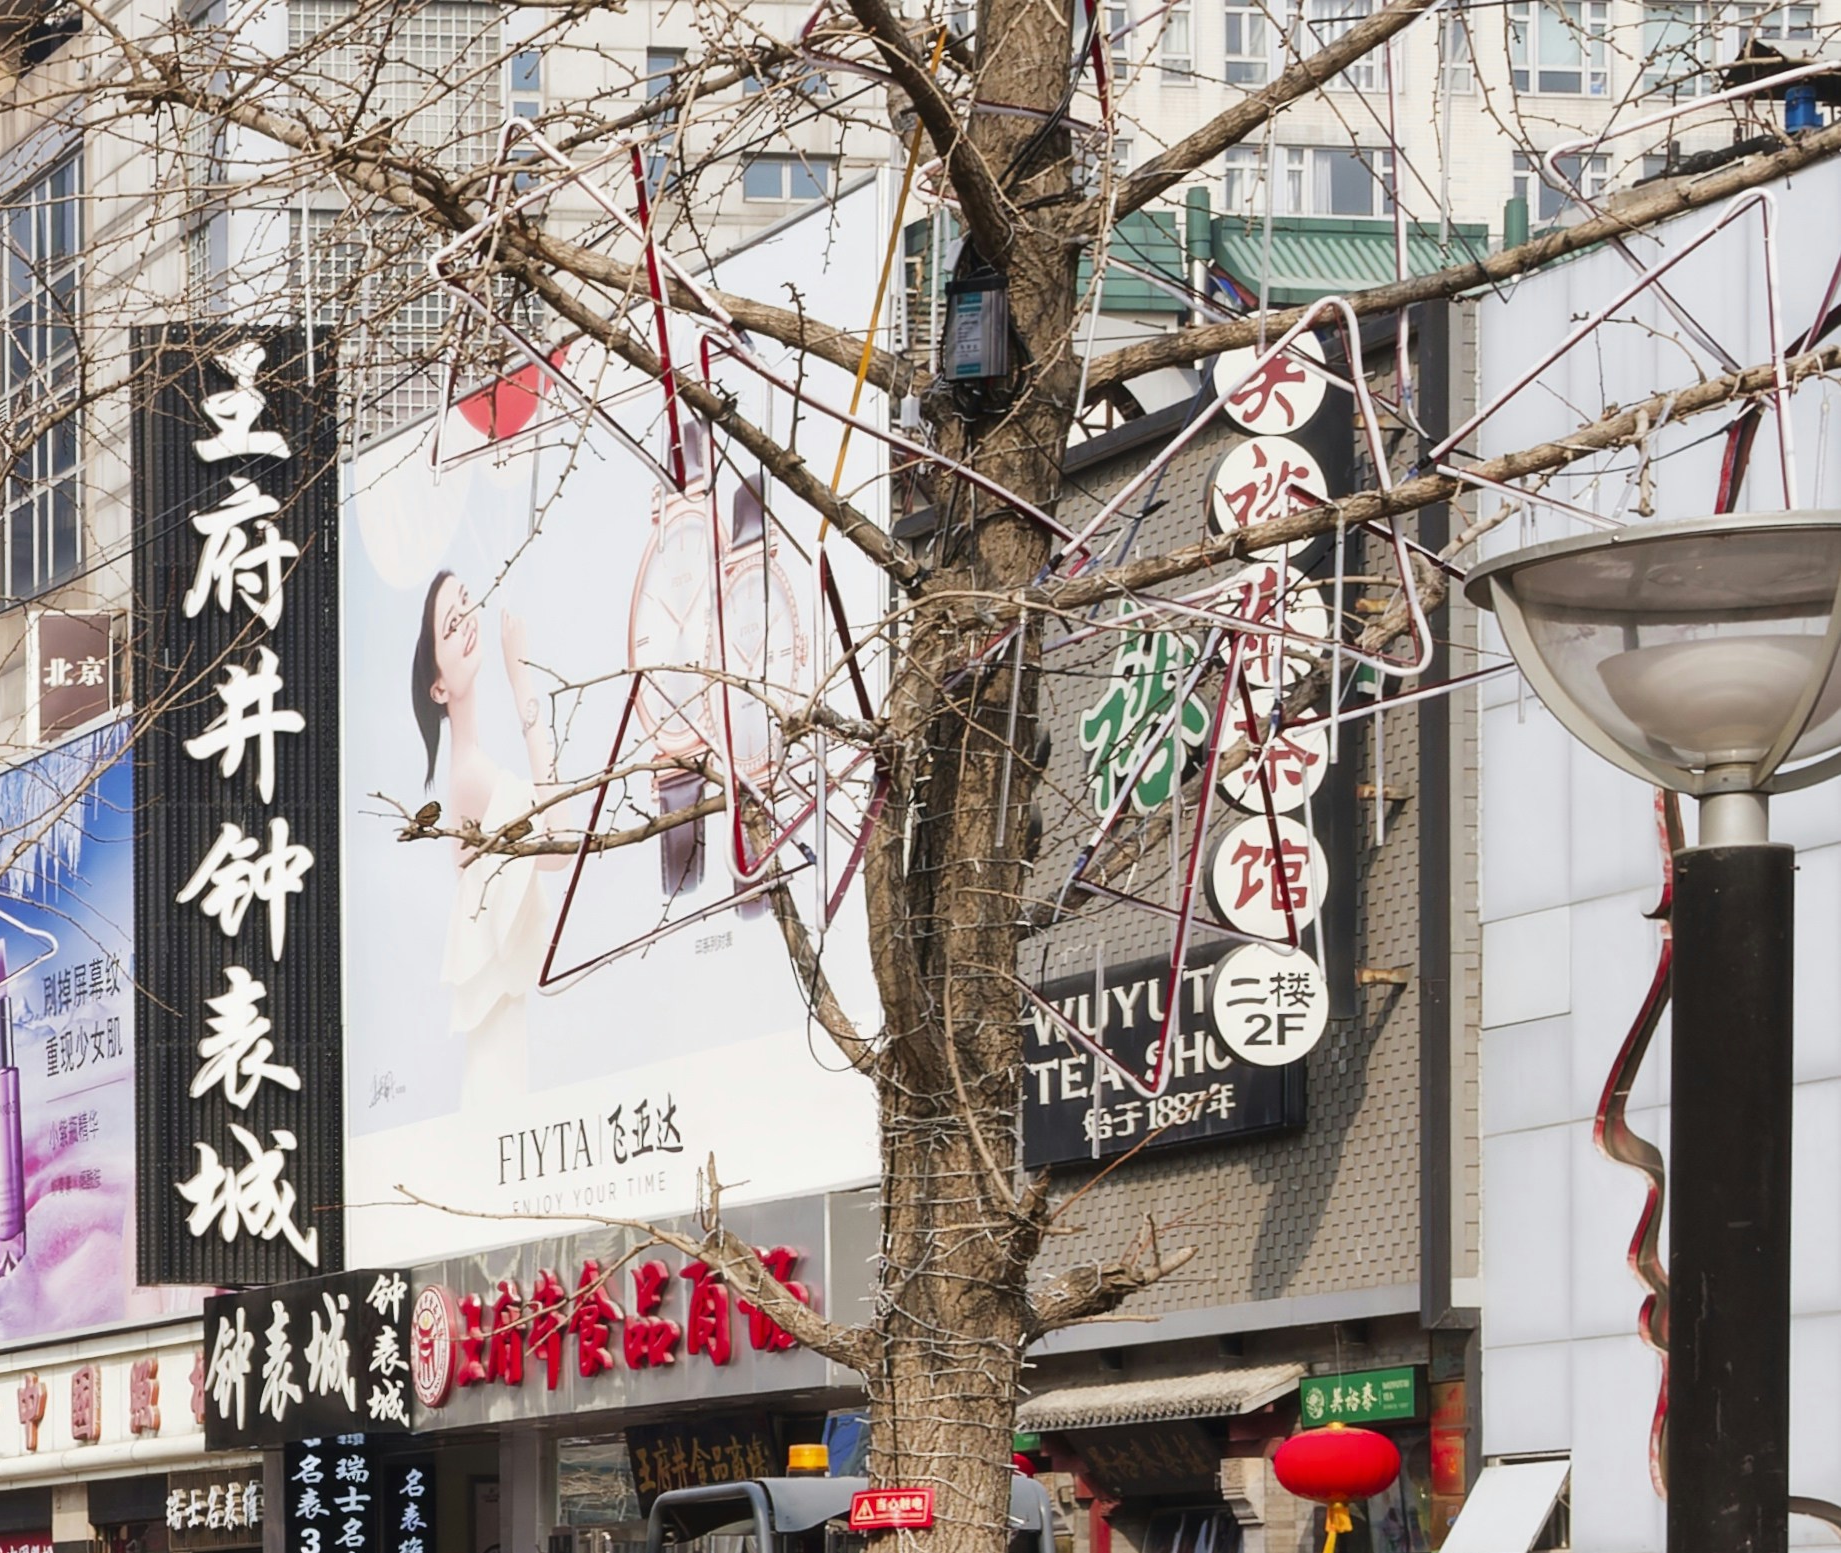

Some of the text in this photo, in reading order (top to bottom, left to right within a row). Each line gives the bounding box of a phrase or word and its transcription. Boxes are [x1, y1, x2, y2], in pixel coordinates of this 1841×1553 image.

[43, 656, 106, 687] 北京
[174, 340, 320, 1268] 王府井钟表城
[42, 952, 121, 1018] 刷掉屏幕纹
[1226, 971, 1316, 1008] 二楼
[46, 1016, 123, 1078] 重现少女肌
[1244, 1013, 1307, 1046] 2F
[1030, 1030, 1232, 1105] TEA SHO
[608, 1092, 684, 1164] 飞亚达
[1082, 1083, 1237, 1142] 始于1887年
[498, 1118, 594, 1186] FIYTA
[513, 1171, 666, 1215] ENJOY YOUR TIME
[205, 1292, 357, 1430] 钟表城
[365, 1272, 411, 1429] 钟表城
